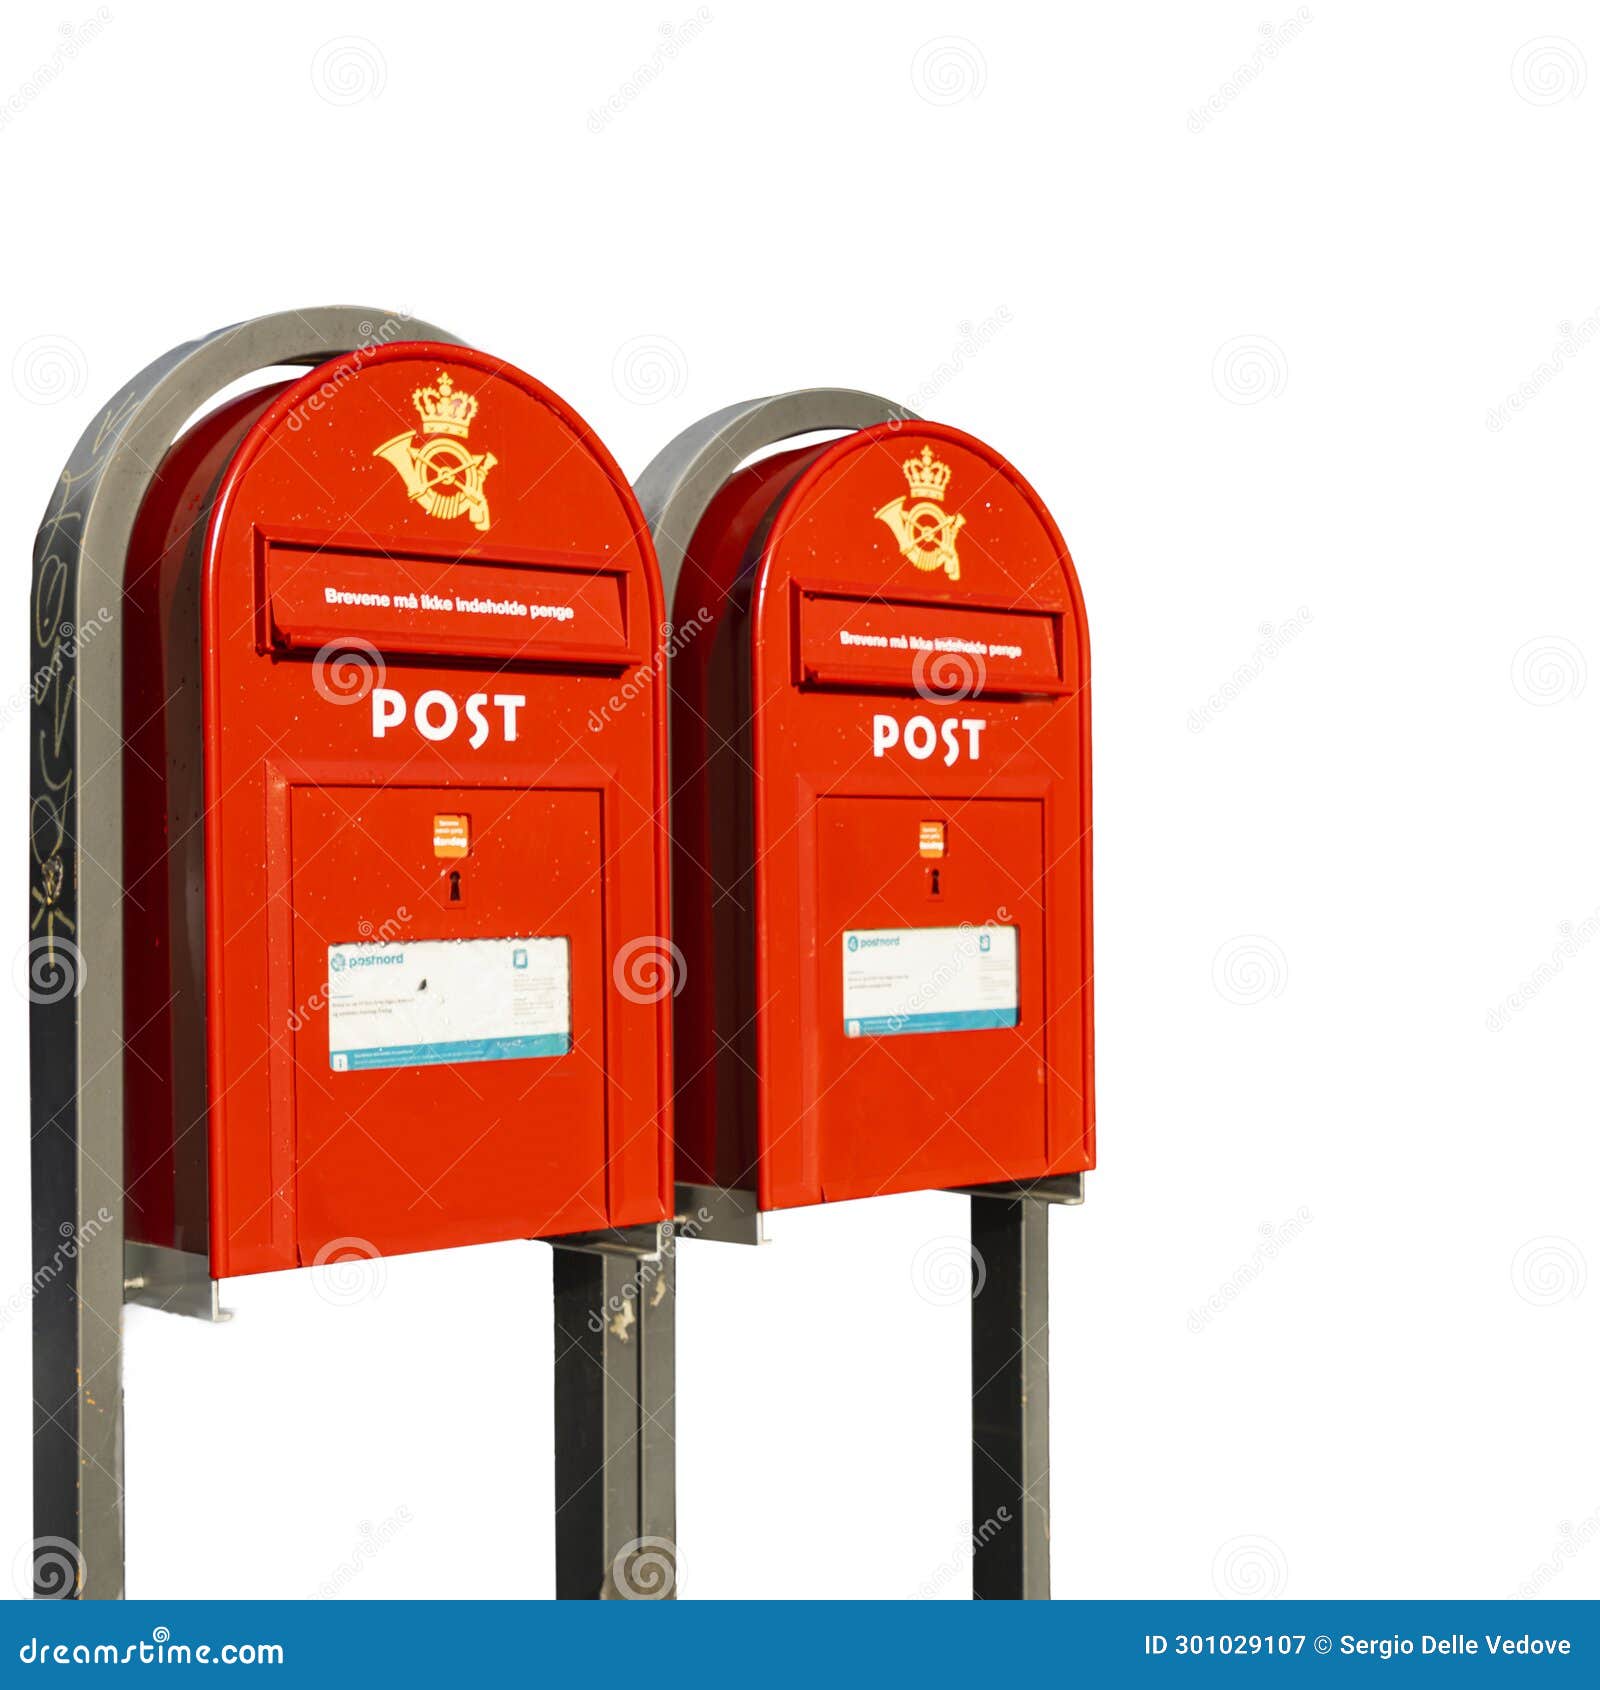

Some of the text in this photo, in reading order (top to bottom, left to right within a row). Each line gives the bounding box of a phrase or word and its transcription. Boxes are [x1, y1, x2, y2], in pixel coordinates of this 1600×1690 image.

[324, 587, 575, 622] Brevene må ikke indeholde penge
[839, 630, 1023, 660] Brevene må ikke indeholde penge
[372, 688, 526, 750] POST
[873, 714, 987, 767] POST
[860, 935, 900, 948] postnord
[348, 953, 404, 969] postnord
